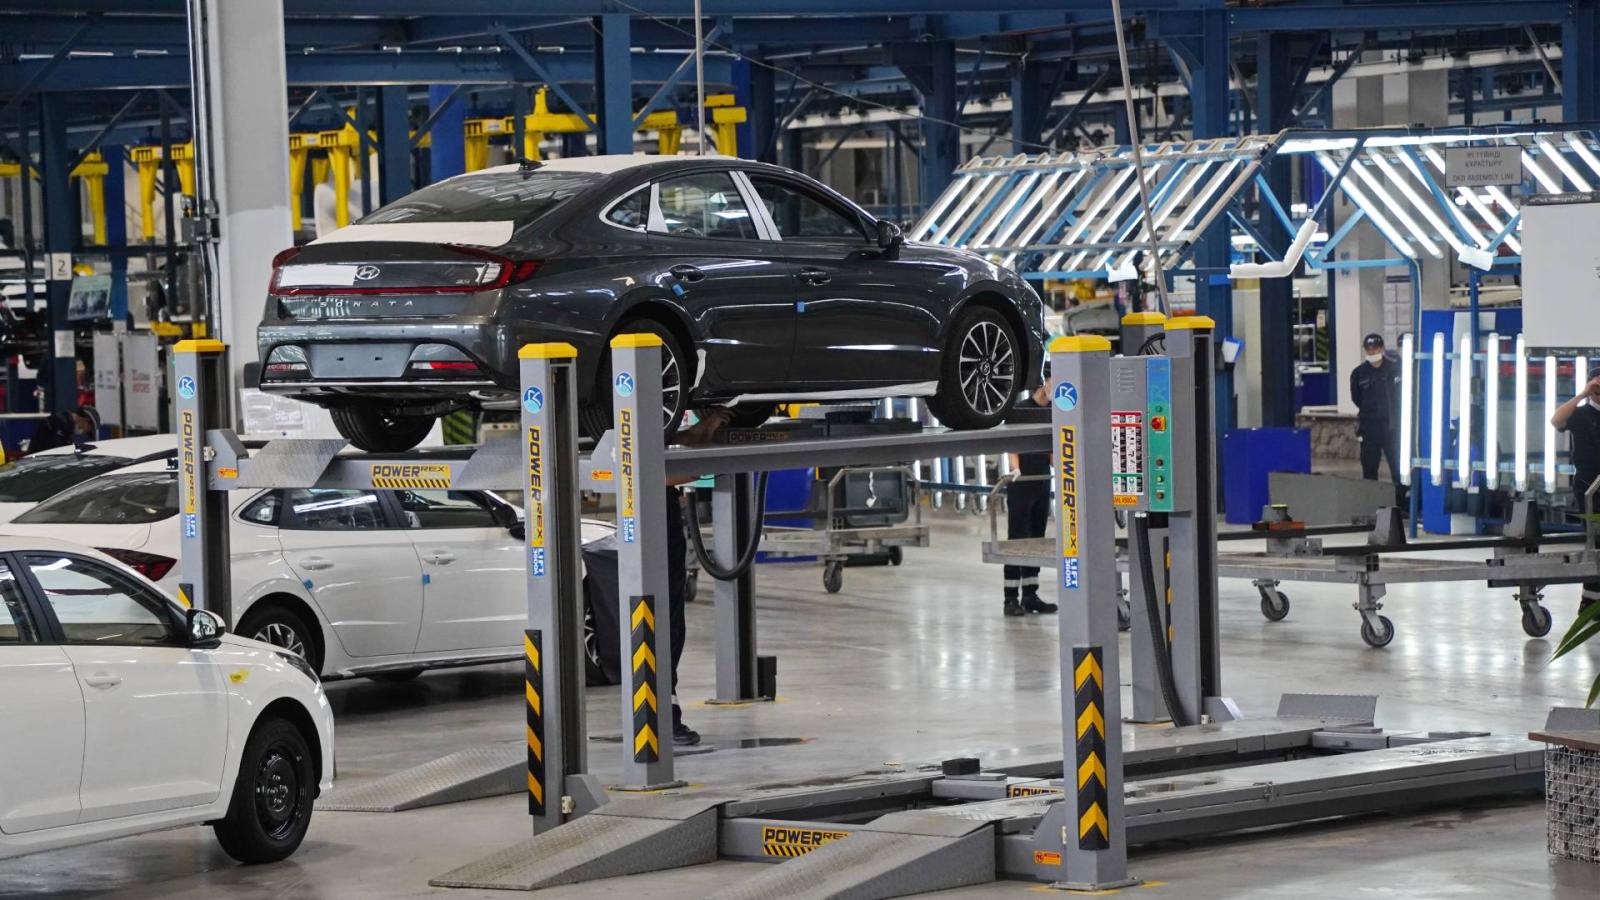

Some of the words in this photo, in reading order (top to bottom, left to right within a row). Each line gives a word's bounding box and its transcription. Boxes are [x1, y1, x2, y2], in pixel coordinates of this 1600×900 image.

[58, 260, 66, 273] 2
[319, 299, 414, 308] SONATA
[765, 828, 848, 845] POWERRE
